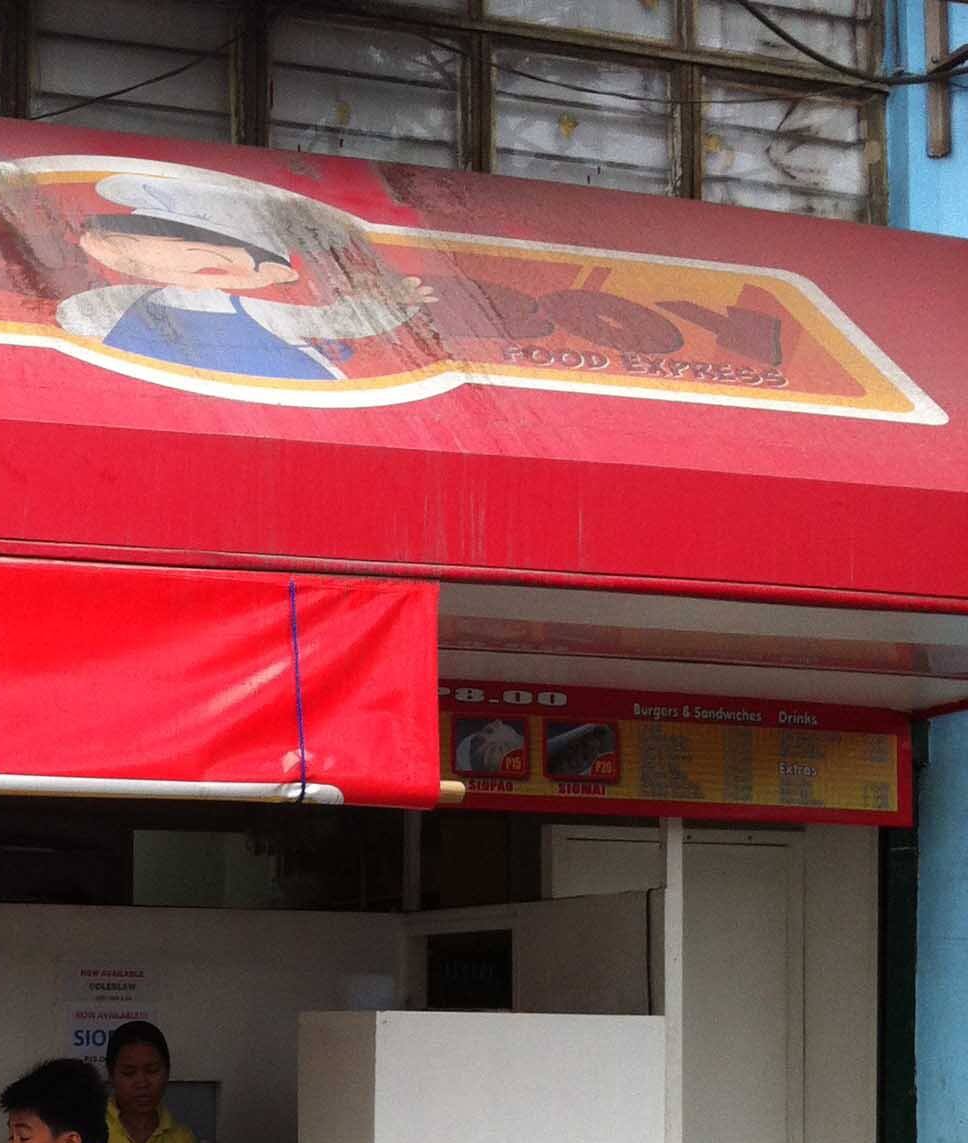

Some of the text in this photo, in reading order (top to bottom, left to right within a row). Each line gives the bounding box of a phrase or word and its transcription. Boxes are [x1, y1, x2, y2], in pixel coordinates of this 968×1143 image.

[506, 344, 790, 389] FOOD EXPRESS
[632, 703, 679, 720] Burgers
[693, 705, 763, 723] Sandwiches
[778, 710, 819, 726] Drinks
[778, 762, 818, 778] Extras
